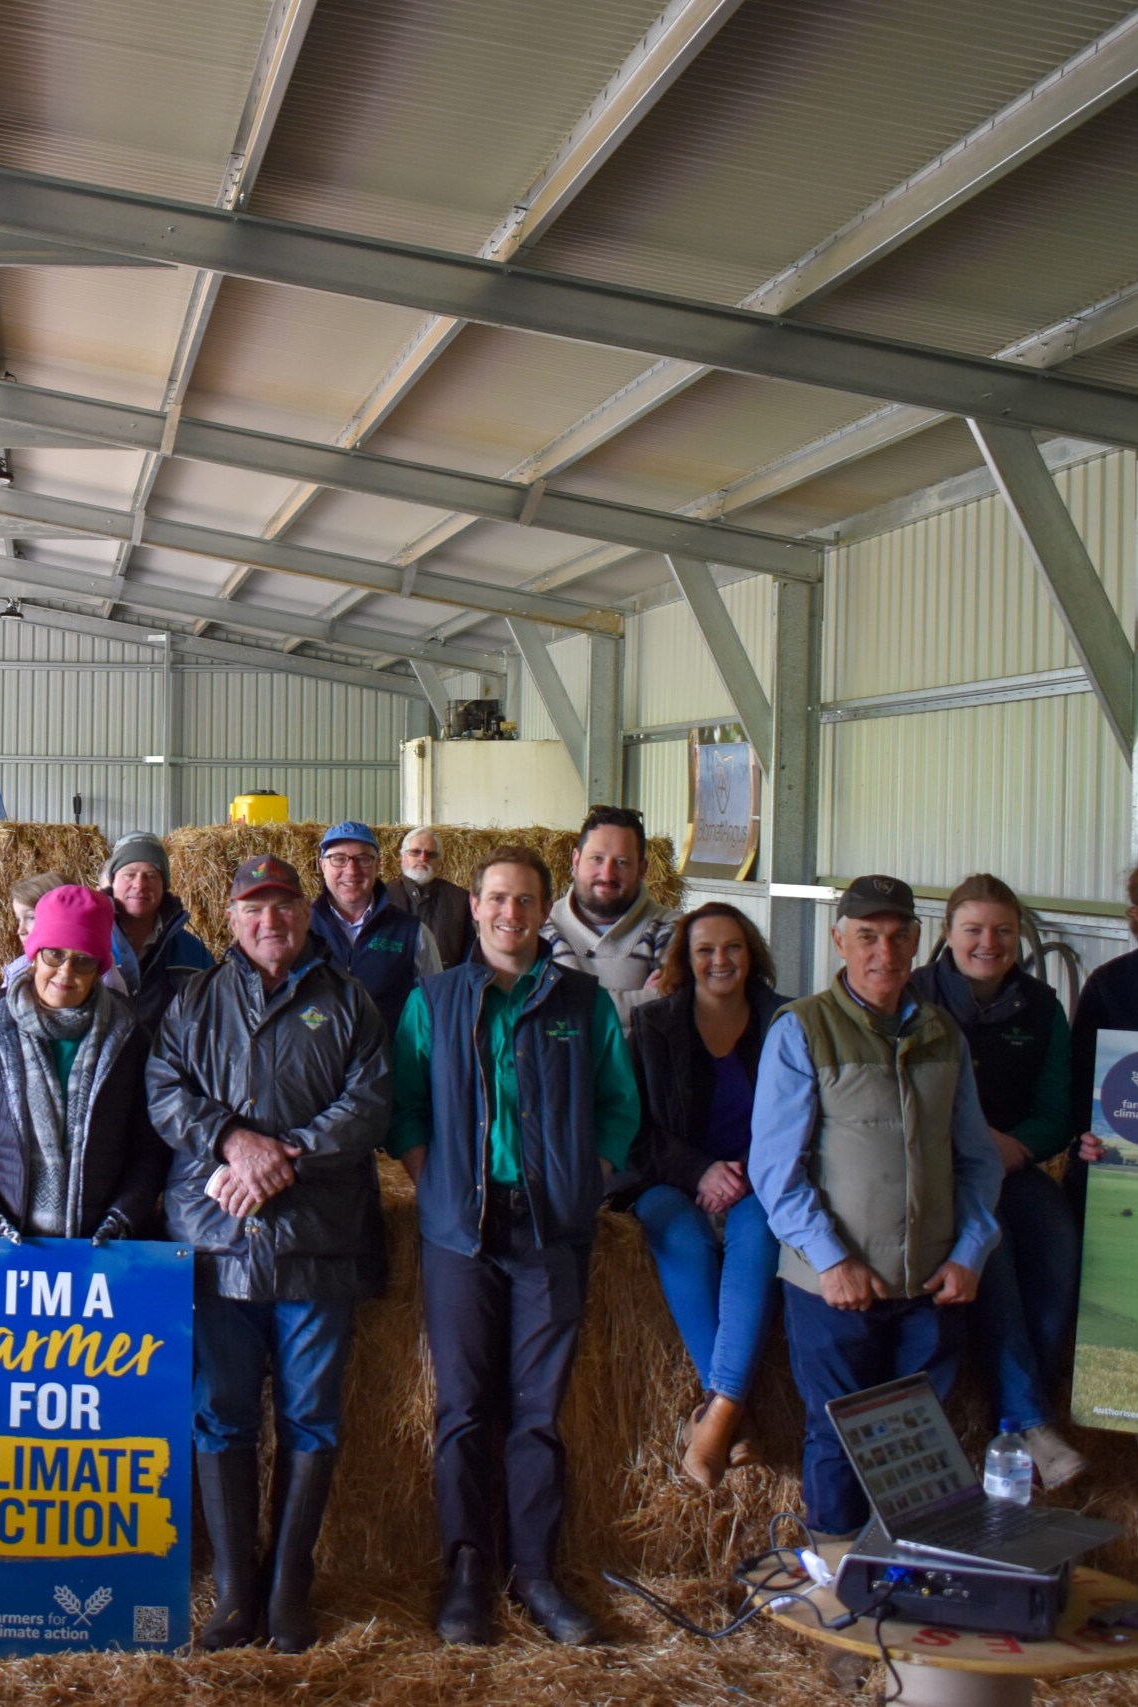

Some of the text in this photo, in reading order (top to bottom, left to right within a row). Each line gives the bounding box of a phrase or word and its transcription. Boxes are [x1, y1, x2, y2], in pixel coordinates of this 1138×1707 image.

[82, 1272, 114, 1318] A
[9, 1382, 101, 1430] FOR
[44, 1626, 89, 1640] action
[48, 1611, 68, 1625] for
